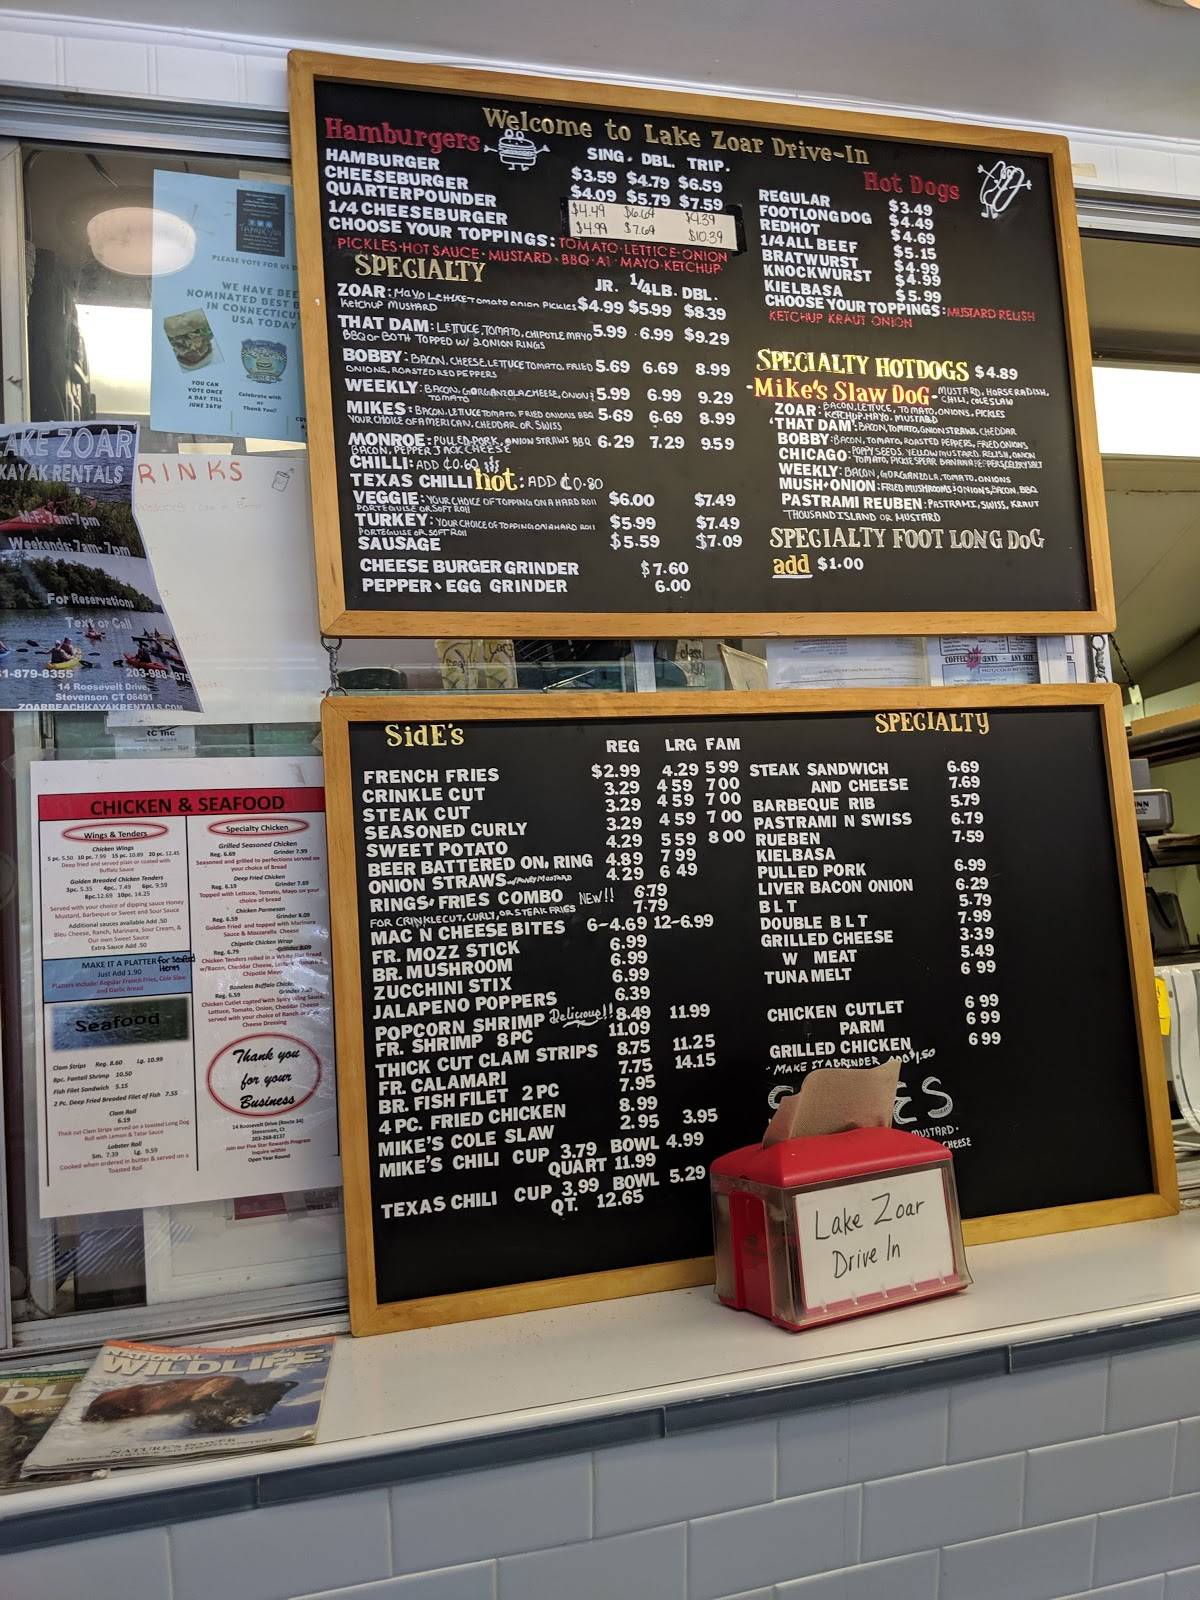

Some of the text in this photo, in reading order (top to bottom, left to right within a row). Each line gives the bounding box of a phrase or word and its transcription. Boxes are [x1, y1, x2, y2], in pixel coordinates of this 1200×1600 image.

[324, 117, 481, 154] Hamburgers
[482, 107, 870, 165] Welcome to Lake Zoar Drive-In
[326, 149, 440, 170] HAMBURGER
[642, 153, 730, 172] DBL. TRIP.
[325, 166, 468, 190] CHEESEBURGER
[571, 166, 723, 194] $3.59 $4.79 $6.59
[864, 170, 960, 202] Hot Dogs
[326, 182, 497, 207] QUARTERPOUNDER
[571, 185, 723, 211] $4.09 $5.79 $7.59
[759, 189, 933, 216] REGULAR $3.49
[329, 200, 508, 225] 1/4 CHEESEBURGER
[329, 217, 555, 247] CHOOSE YOUR TOPPINGS:
[576, 222, 607, 235] $4.99
[355, 254, 485, 282] SPECIALTY
[764, 264, 941, 288] KNOCKWURST $4.99
[222, 281, 274, 297] WE HAVE
[595, 279, 618, 292] JR.
[682, 287, 718, 301] DBL.
[764, 280, 843, 297] KIELBASA
[186, 289, 290, 308] NOMINATED BEST
[628, 300, 726, 320] $5.99 $8.39
[770, 310, 822, 323] KETCHUP
[828, 314, 865, 325] KRAUT
[232, 316, 297, 329] USA TODAY
[338, 315, 384, 330] THAT
[640, 327, 730, 345] 6.99 $9.29
[756, 349, 1018, 382] SPECIALTY HOTDOGS $4.89
[647, 389, 734, 404] 6.99 9.29
[754, 377, 828, 401] Mike's
[833, 381, 887, 403] Slaw
[0, 428, 133, 459] AKE ZOAR
[53, 464, 123, 484] RENTALS
[138, 461, 243, 484] RINKS
[351, 473, 413, 488] TEXAS
[419, 474, 472, 489] CHILLI
[358, 537, 441, 551] SAUSAGE
[610, 532, 742, 550] $5.59 $7.09
[770, 527, 887, 548] SPECIALTY
[892, 528, 944, 548] FOOT
[949, 530, 1003, 549] LONG
[360, 558, 579, 575] CHEESE BURGER GRINDER
[774, 554, 864, 574] add $1.00
[446, 579, 481, 593] EGG
[490, 579, 568, 593] GRINDER
[47, 593, 68, 605] For
[65, 617, 132, 630] Text Call
[56, 693, 108, 701] Stevenson
[606, 738, 740, 752] REG LRG FAM
[363, 768, 499, 784] FRENCH FRIES
[591, 763, 699, 779] $2.99 4.29
[750, 760, 979, 777] STEAK SANDWICH 6.69
[362, 787, 485, 803] CRINKLE CUT
[604, 781, 640, 795] 3.29
[91, 795, 285, 815] CHICKEN & SEAFOOD
[753, 797, 876, 812] BARBEQUE RIB
[84, 830, 148, 840] Wings Tenders
[226, 825, 258, 833] Specialty
[366, 842, 508, 858] SWEET POTATO
[758, 863, 866, 879] PULLED PORK
[954, 859, 986, 872] 6.99
[369, 873, 507, 894] ONION STRAWS
[374, 977, 512, 1000] ZUCCHINI STIX
[373, 986, 651, 1019] JALAPENO POPPERS 6.39
[767, 1001, 904, 1022] CHICKEN CUTLET
[616, 1004, 710, 1021] 8.49 11.99
[75, 1013, 160, 1033] Seafood
[233, 1048, 300, 1064] Thank you
[375, 1044, 599, 1078] THICK CUT CLAM STRIPS
[241, 1072, 292, 1090] for your
[241, 1094, 295, 1109] Business
[611, 1132, 704, 1153] BOWL 4.99
[381, 1191, 497, 1219] TEXAS CHILI
[816, 1192, 925, 1240] Lake Zoar
[832, 1234, 900, 1278] Drive In
[103, 1349, 326, 1377] WILDLIFE
